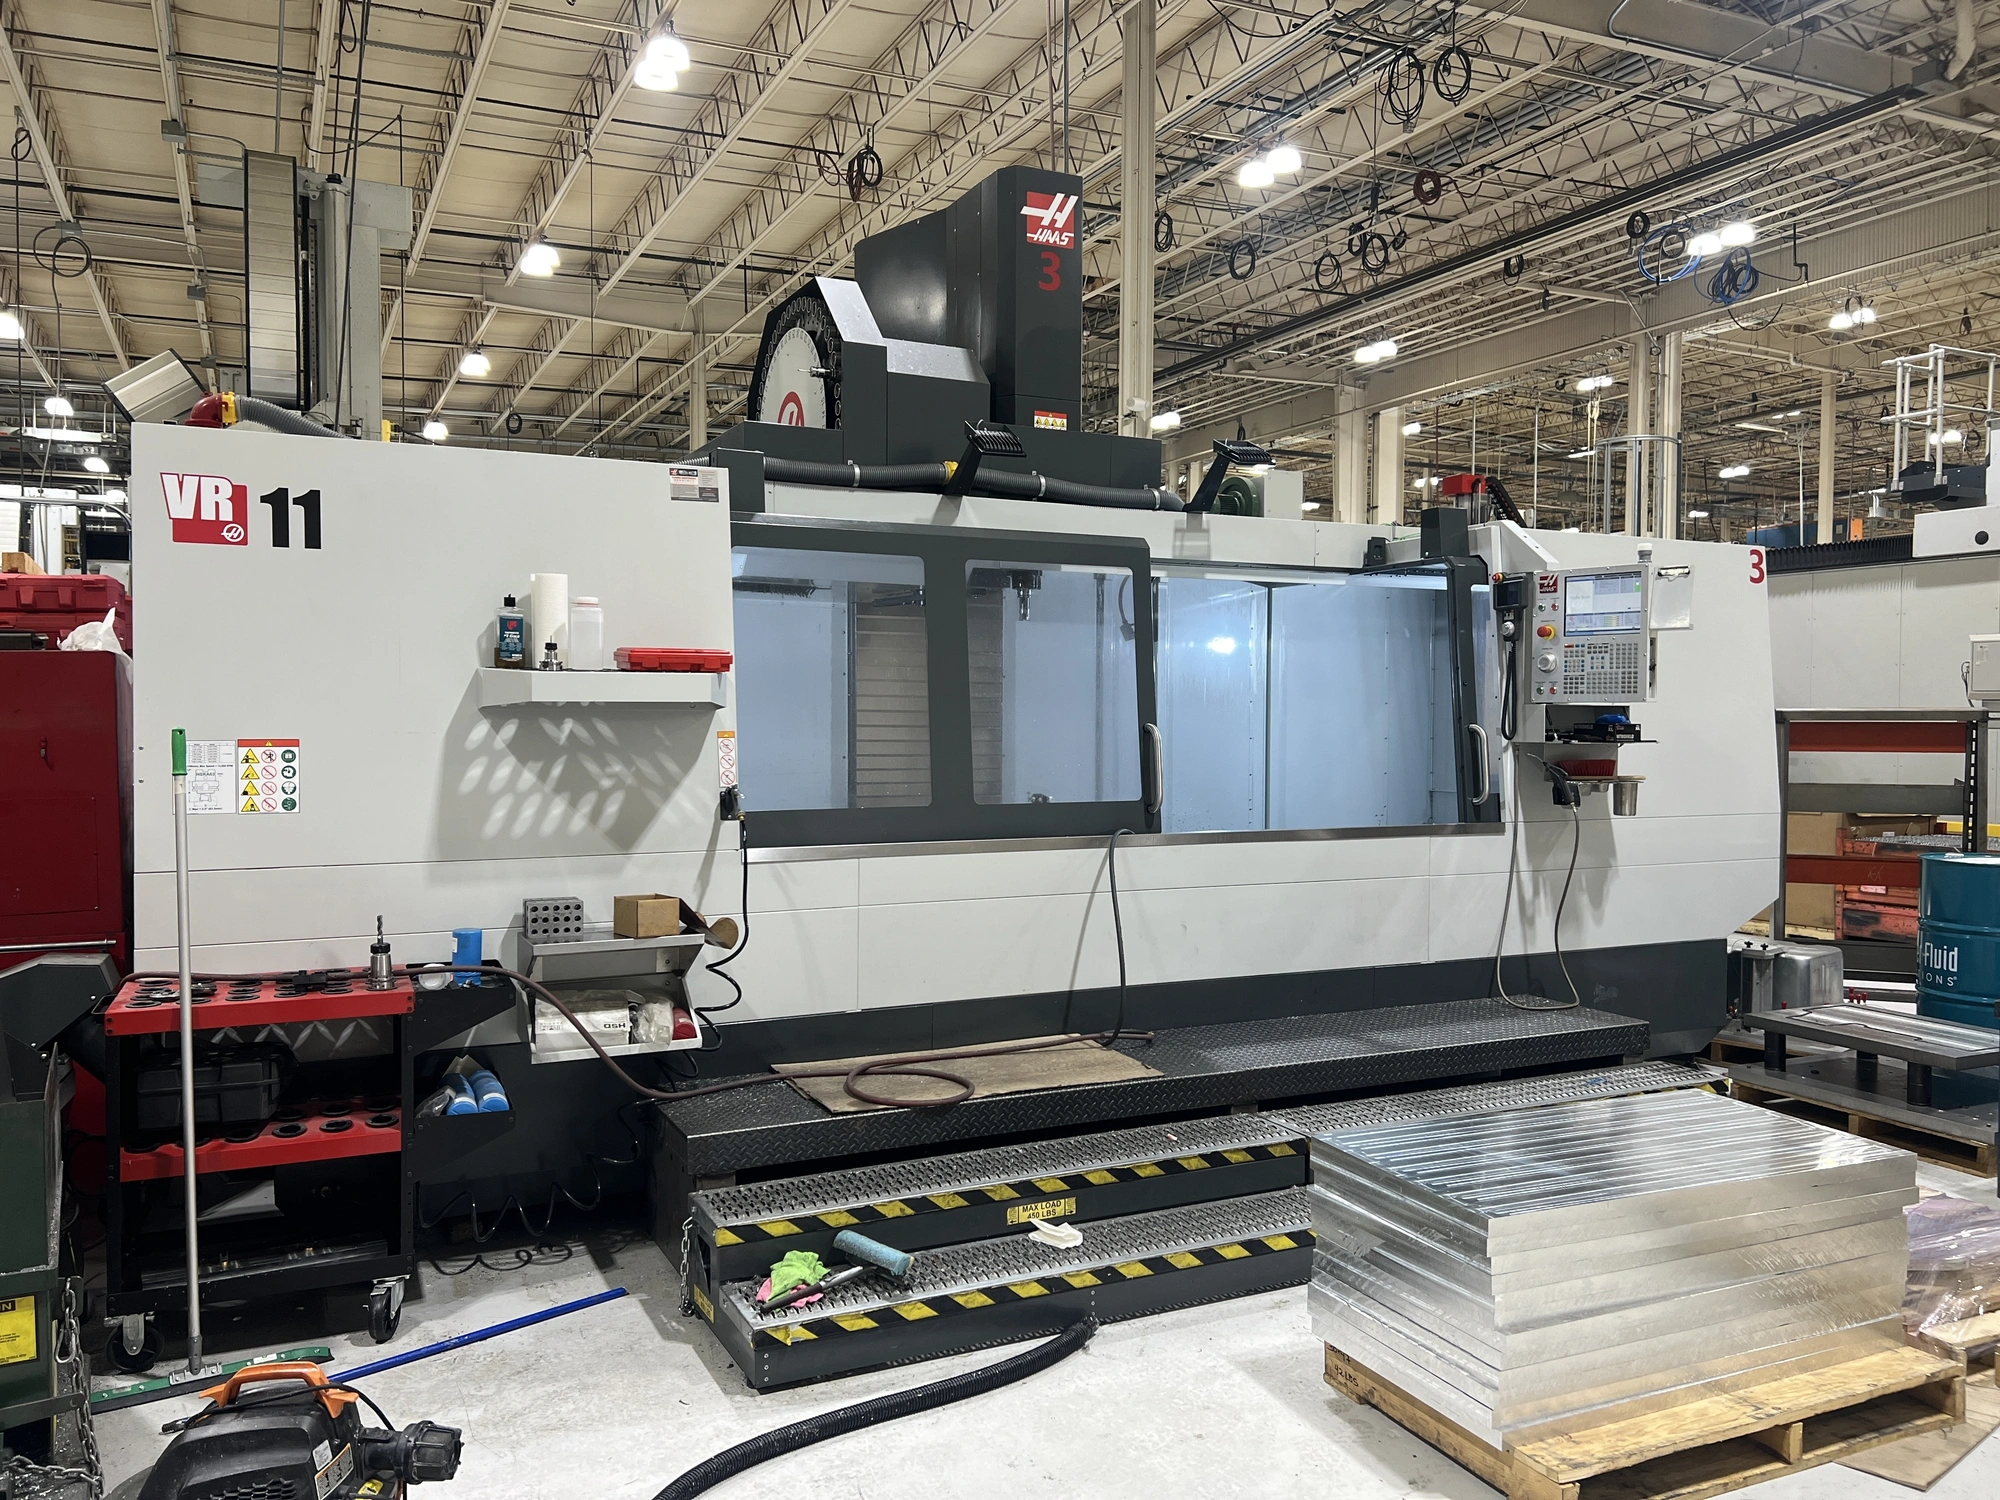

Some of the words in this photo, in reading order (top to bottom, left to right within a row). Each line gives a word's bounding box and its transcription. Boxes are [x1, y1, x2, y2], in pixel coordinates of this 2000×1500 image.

[1026, 228, 1075, 246] HAAS
[1038, 251, 1061, 291] 3
[160, 472, 234, 523] VR
[259, 487, 322, 550] 11
[1749, 548, 1765, 584] 3
[1022, 1204, 1039, 1213] MAX
[1040, 1200, 1062, 1210] LOAD
[1041, 1208, 1057, 1217] LBS
